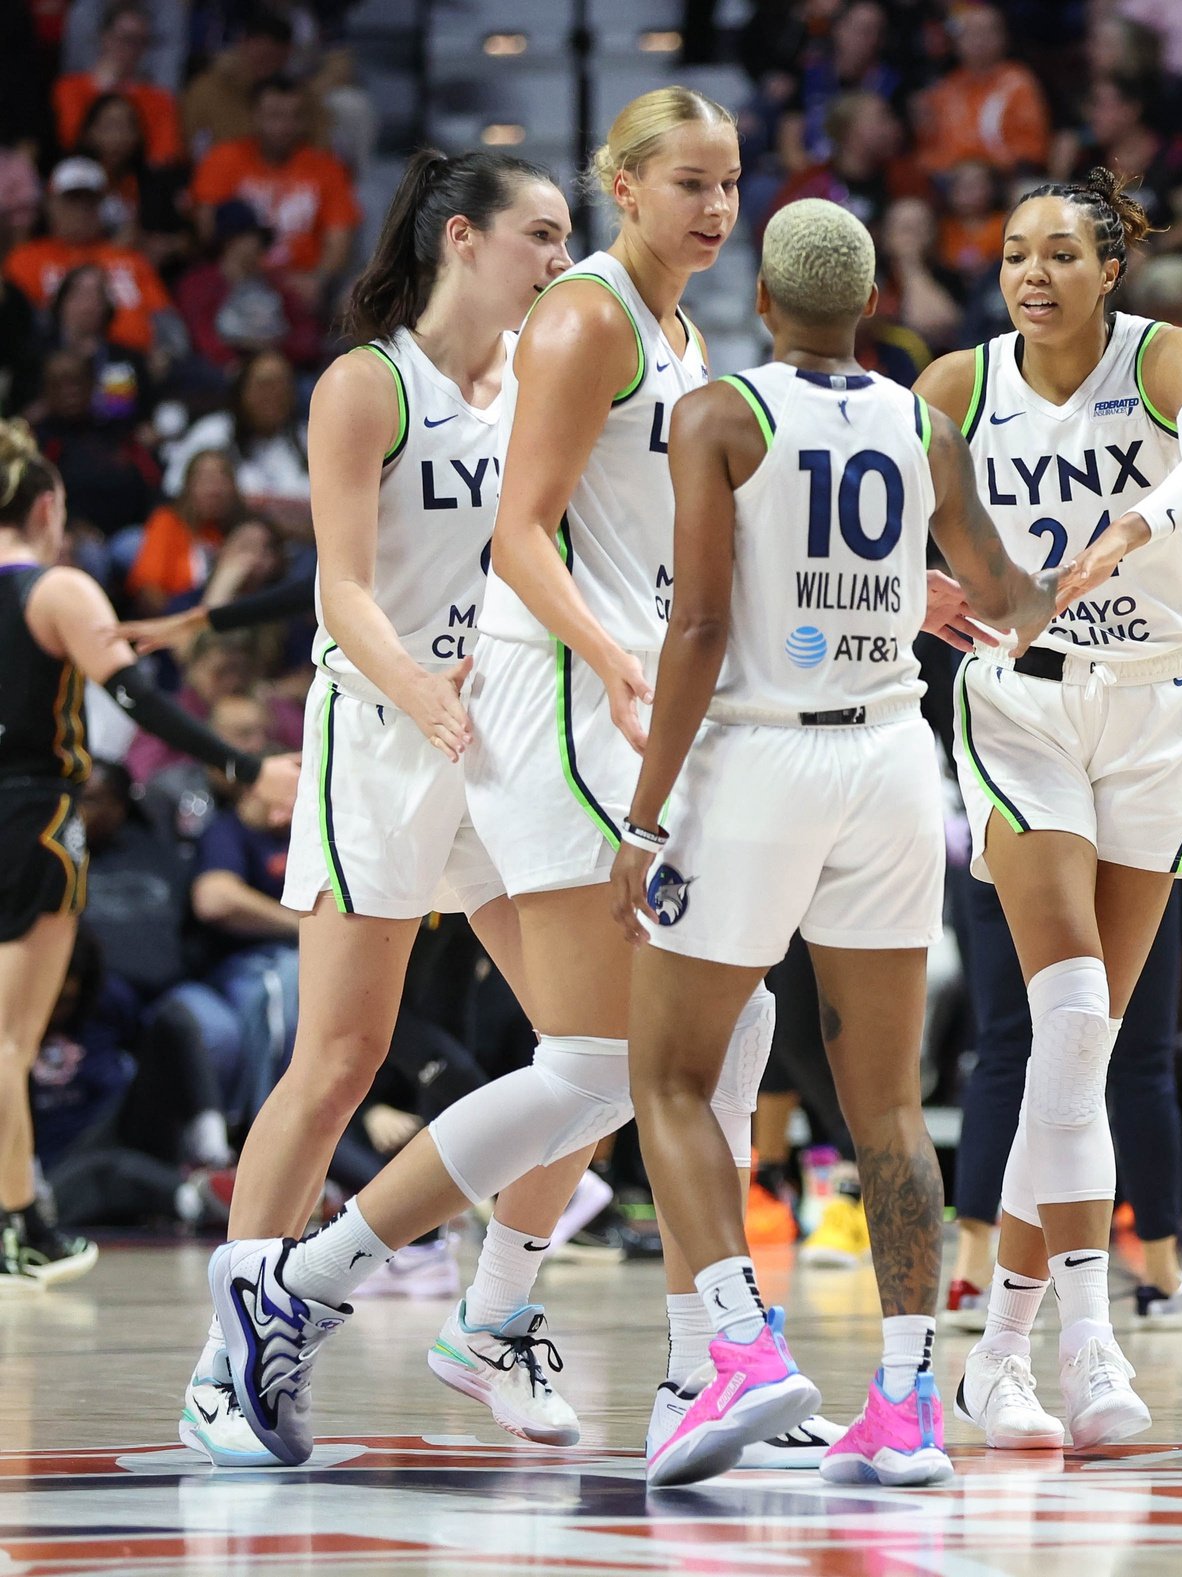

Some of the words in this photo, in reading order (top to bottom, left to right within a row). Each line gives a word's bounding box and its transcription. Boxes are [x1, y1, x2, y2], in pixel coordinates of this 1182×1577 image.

[1094, 398, 1139, 411] FEDERATED
[421, 456, 500, 510] LY
[987, 440, 1151, 506] LYNX
[798, 449, 905, 561] 10
[797, 571, 901, 613] WILLIAMS
[1051, 596, 1137, 624] MAYO
